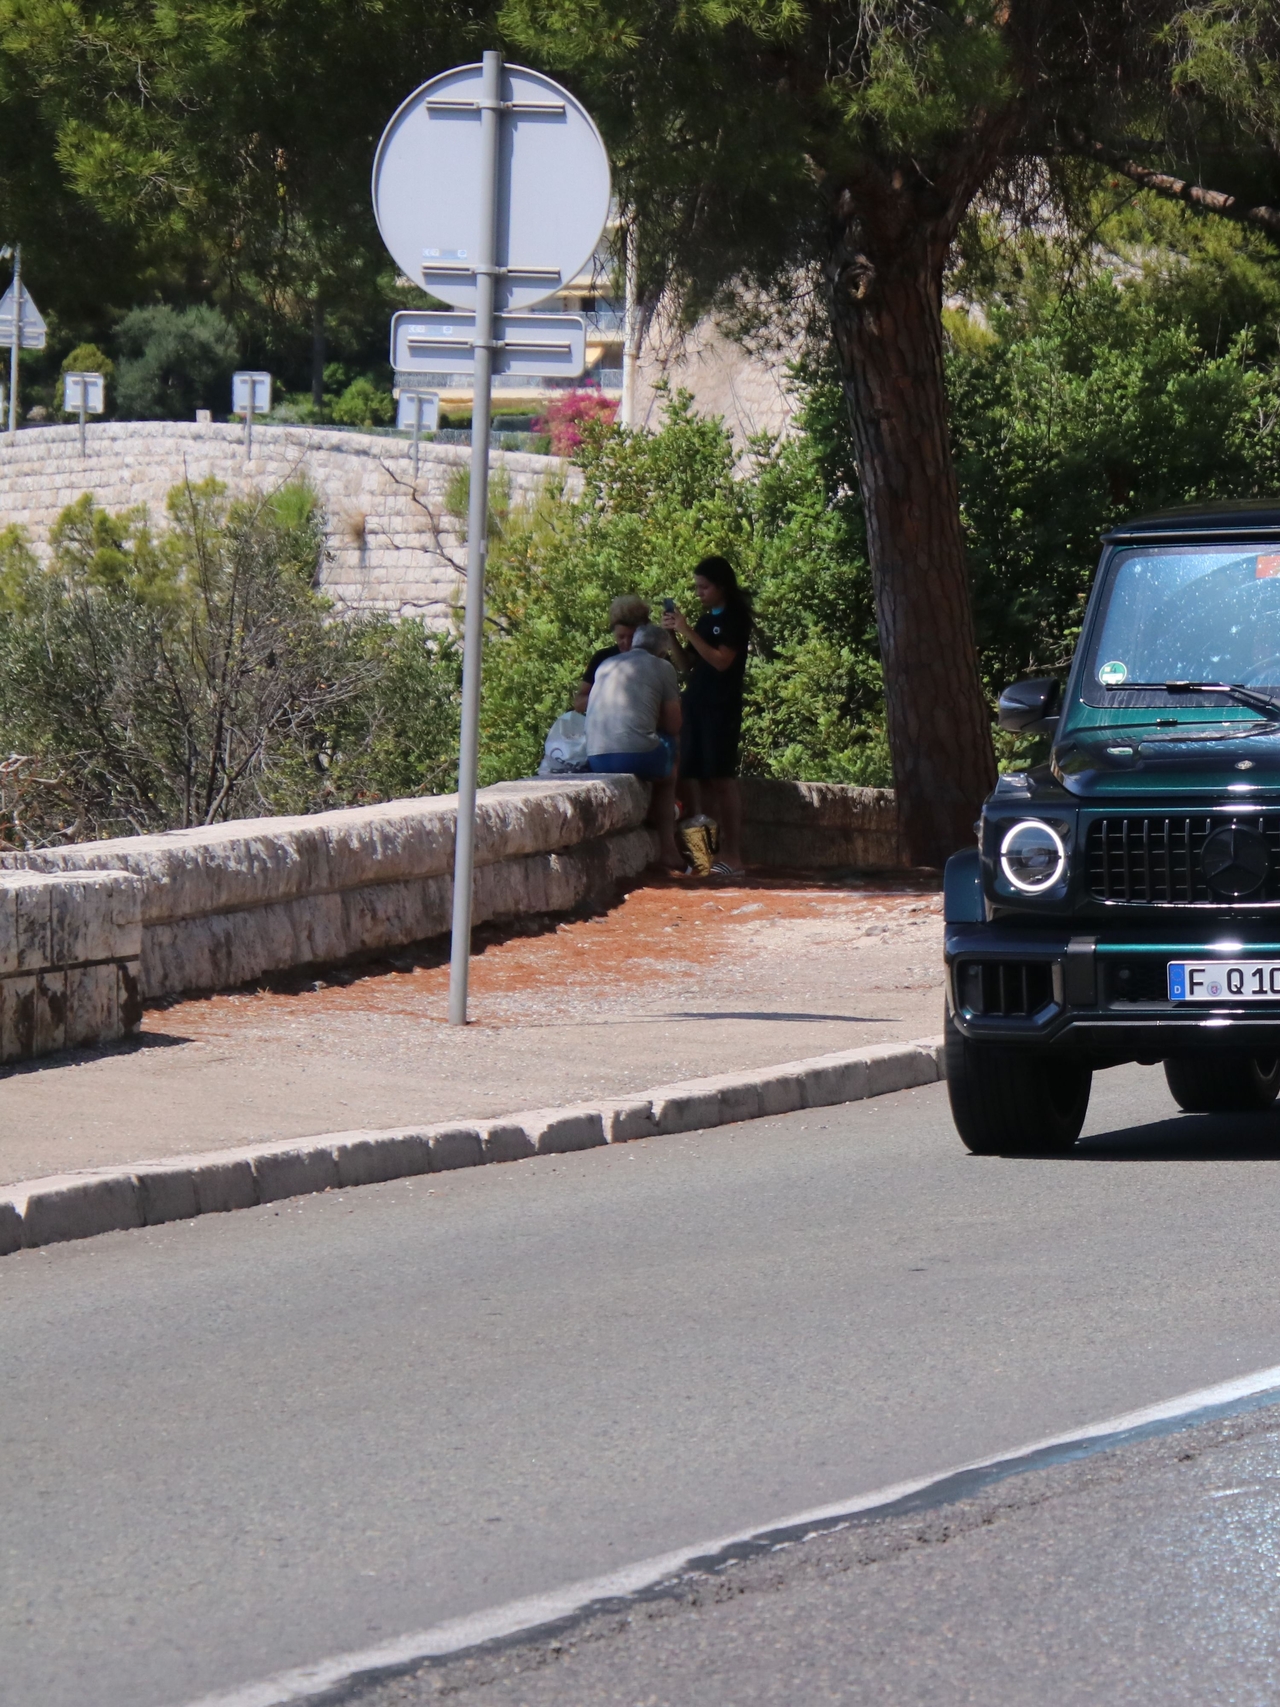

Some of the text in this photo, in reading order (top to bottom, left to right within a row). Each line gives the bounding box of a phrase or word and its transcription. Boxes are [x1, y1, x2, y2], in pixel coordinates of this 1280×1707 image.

[1174, 985, 1181, 994] D
[1188, 968, 1206, 996] F
[1226, 967, 1244, 995] Q
